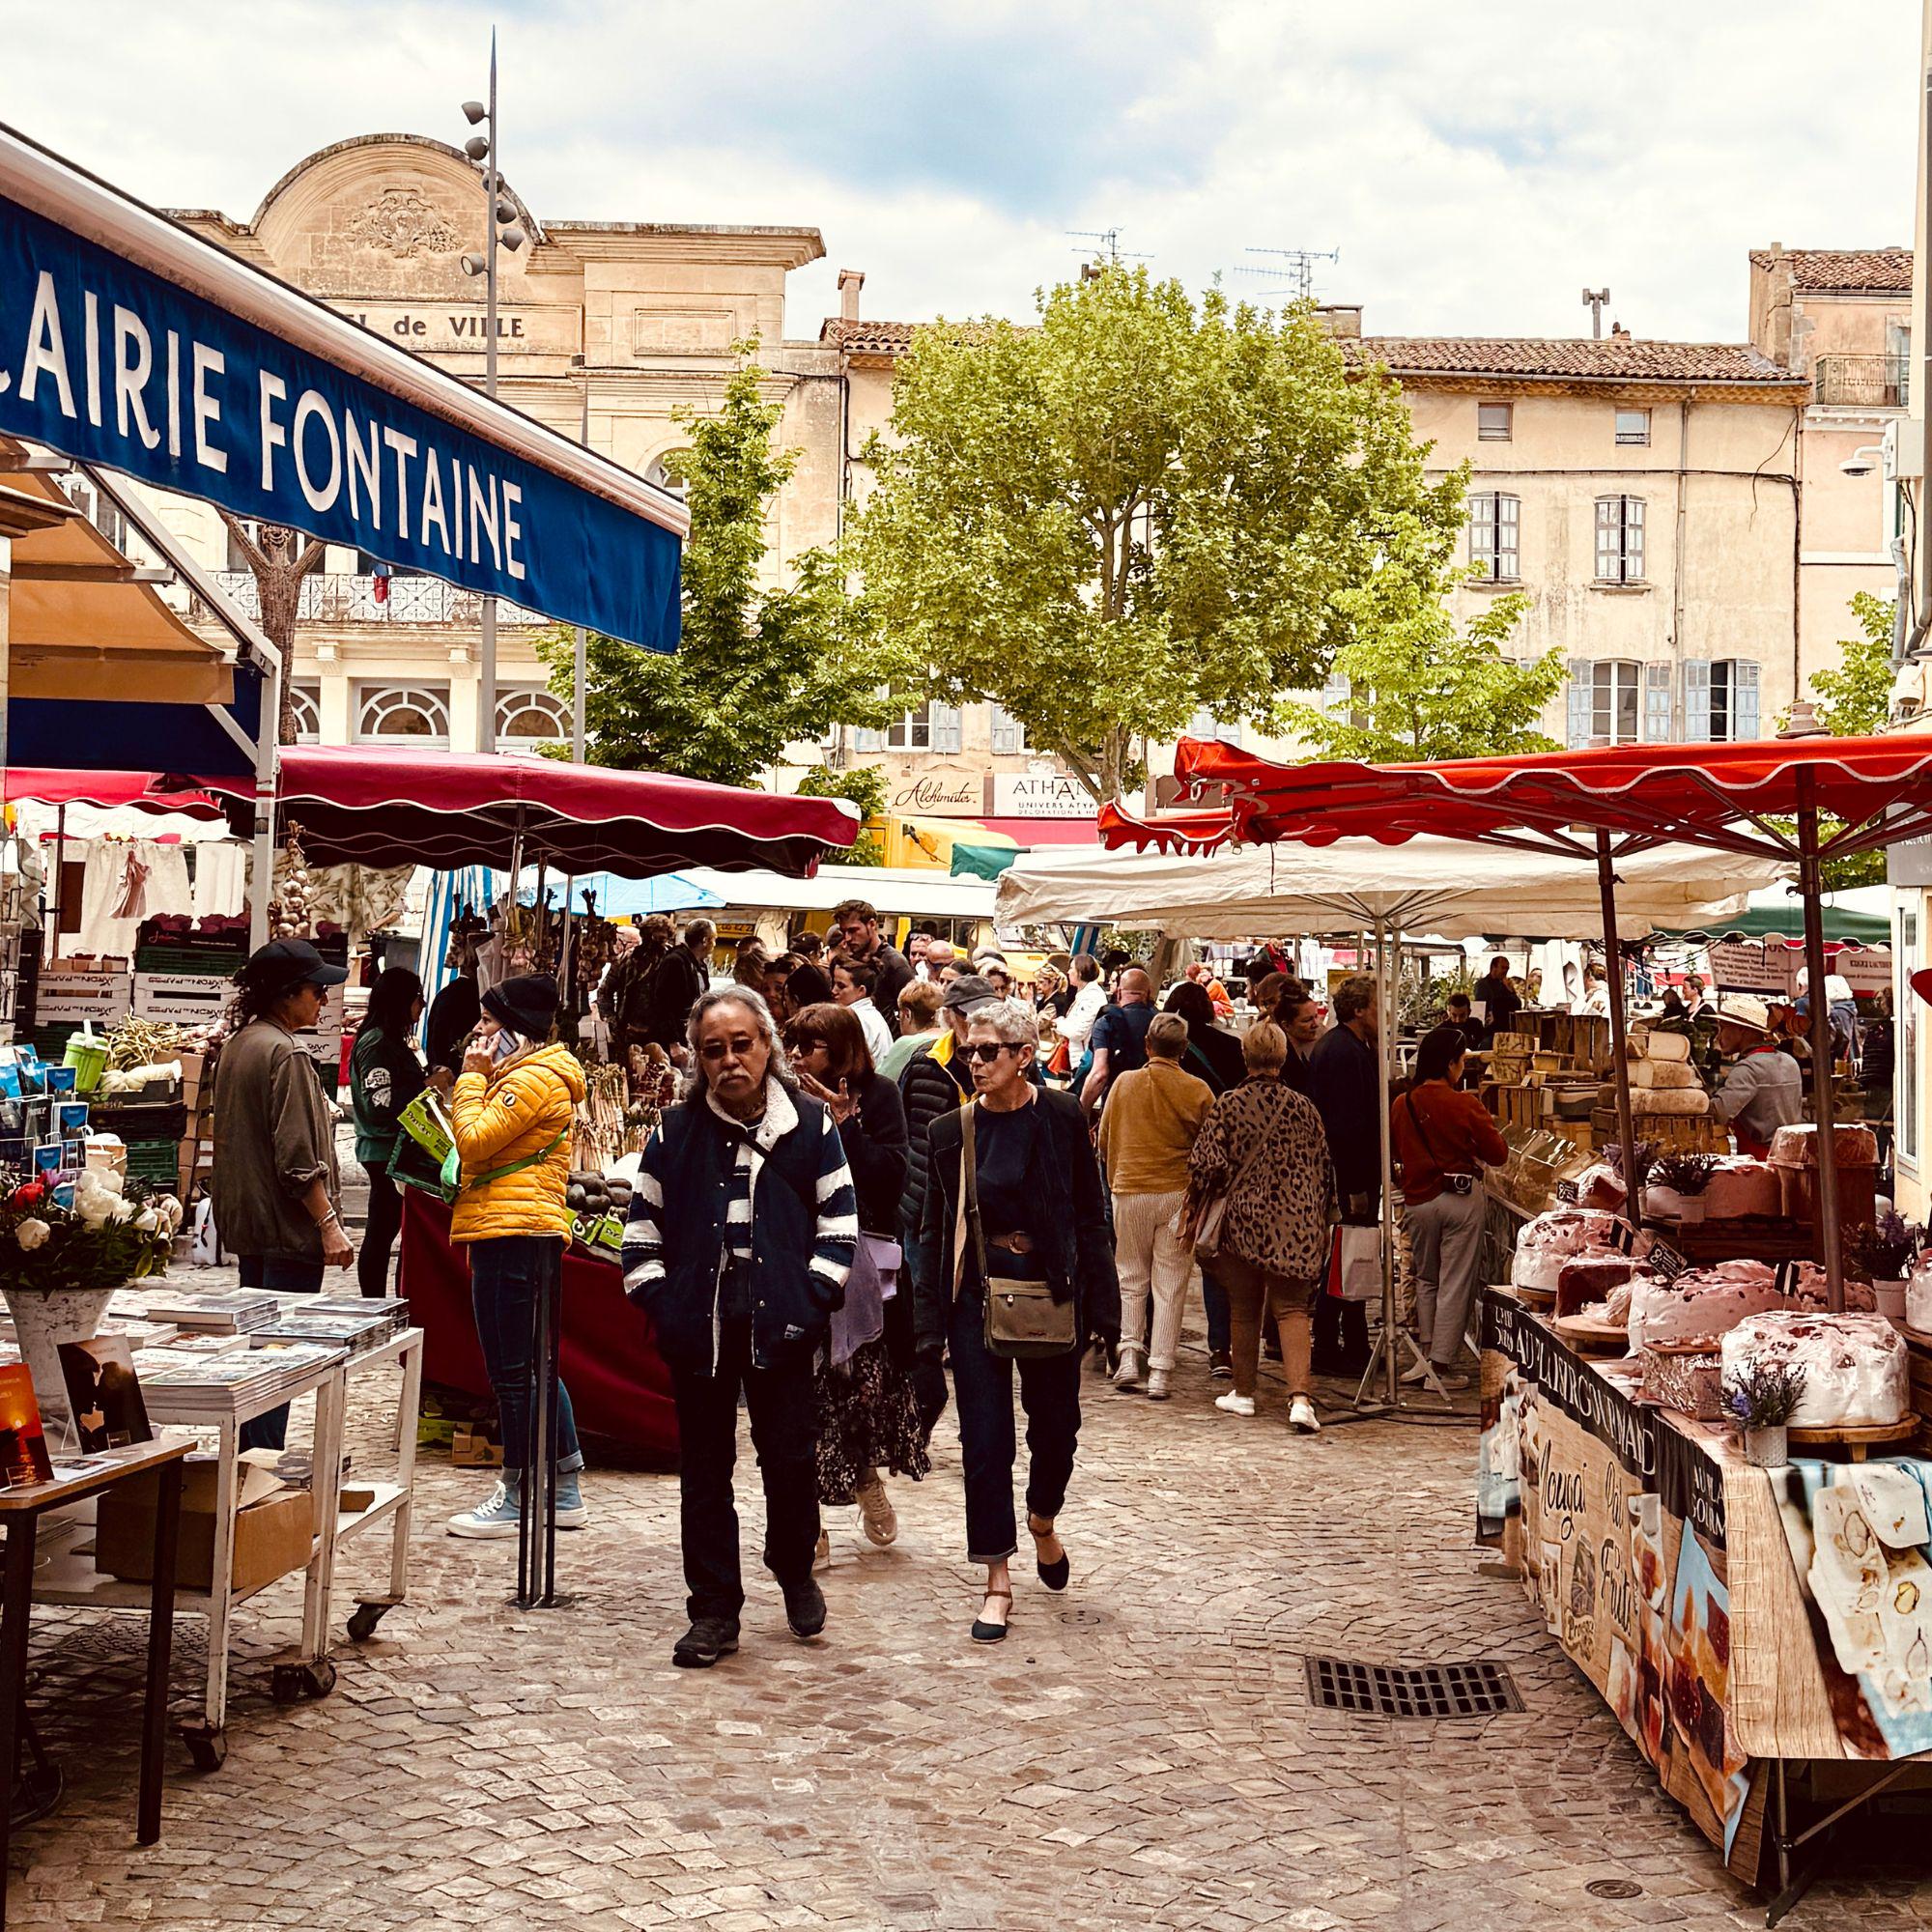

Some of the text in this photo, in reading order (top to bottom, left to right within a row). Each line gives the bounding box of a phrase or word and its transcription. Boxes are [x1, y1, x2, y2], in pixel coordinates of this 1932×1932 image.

[393, 315, 526, 337] de VILLE
[0, 270, 526, 581] AIRIE FONTAINE
